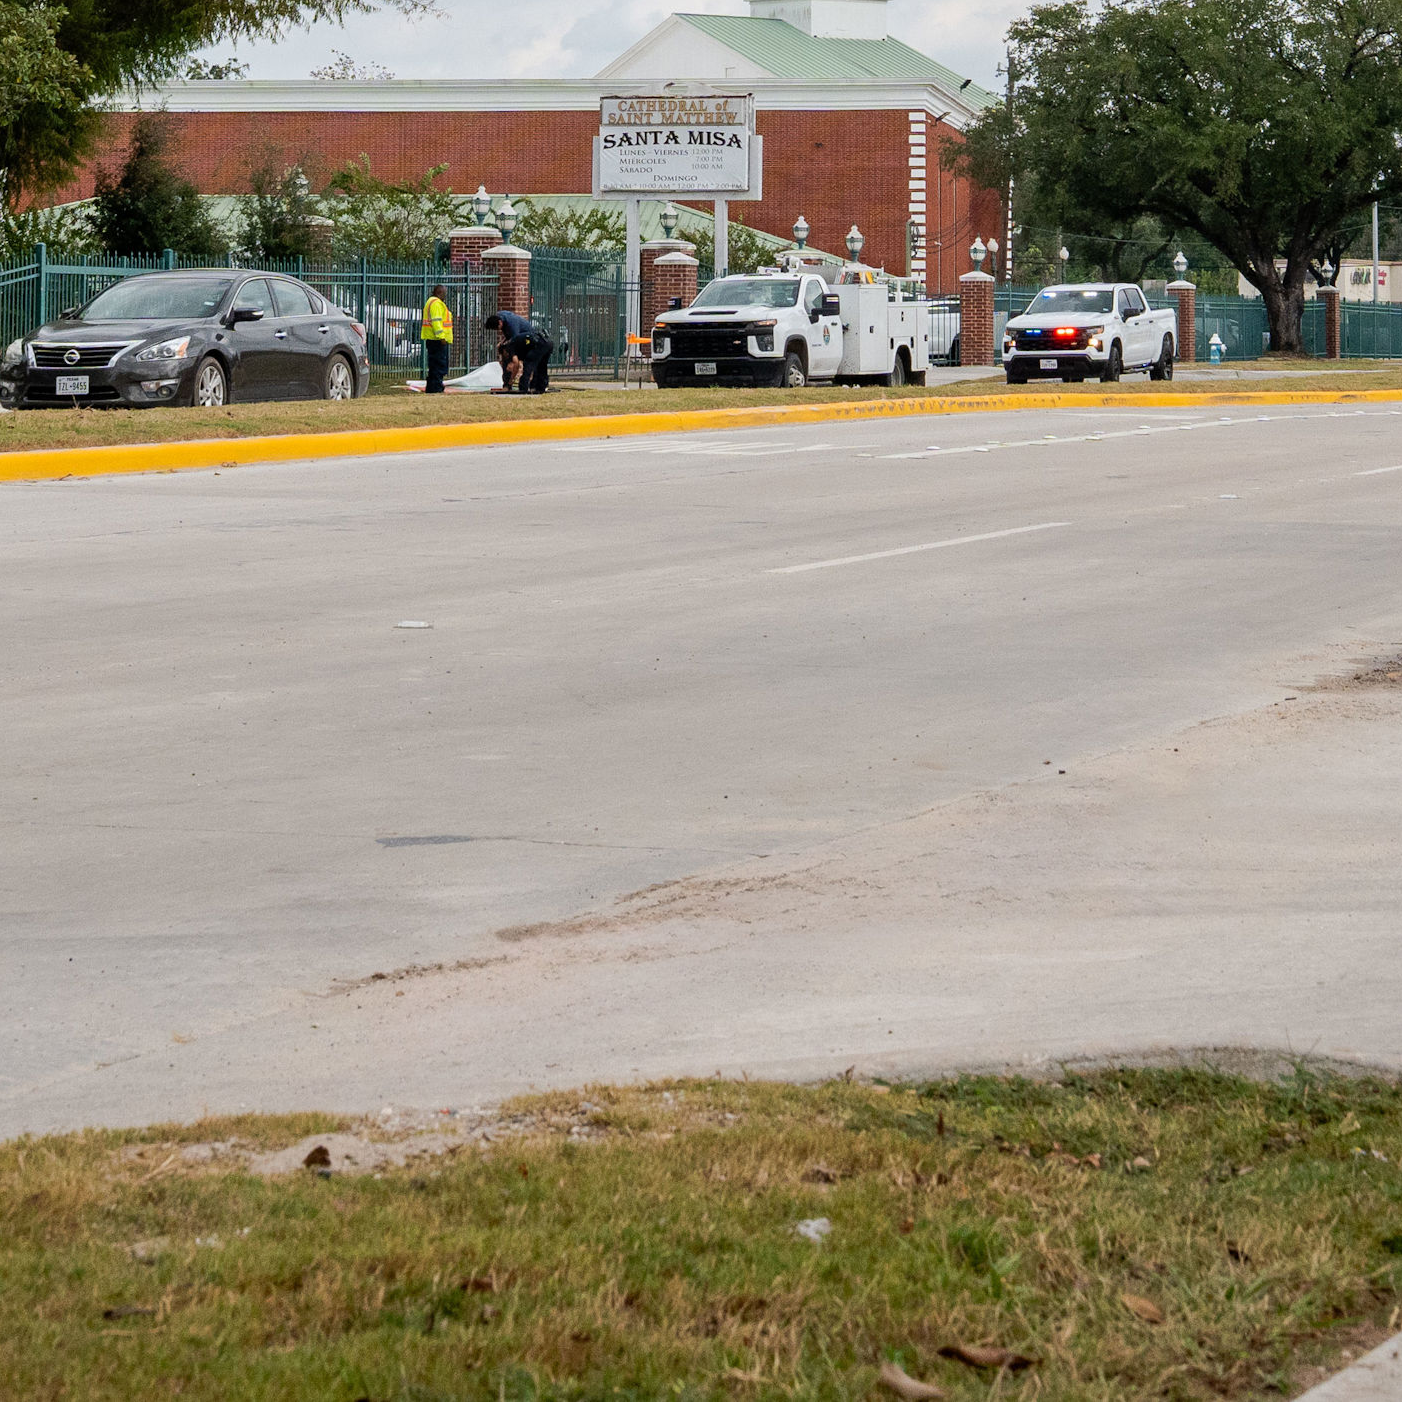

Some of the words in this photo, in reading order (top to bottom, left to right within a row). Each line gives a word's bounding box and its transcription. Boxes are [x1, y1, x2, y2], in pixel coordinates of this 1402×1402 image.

[618, 100, 708, 112] CATHEDRAL
[715, 100, 729, 111] of
[608, 112, 654, 124] SAINT
[662, 112, 738, 124] MATTHEW
[603, 130, 681, 150] SANTA
[687, 130, 743, 149] MISA
